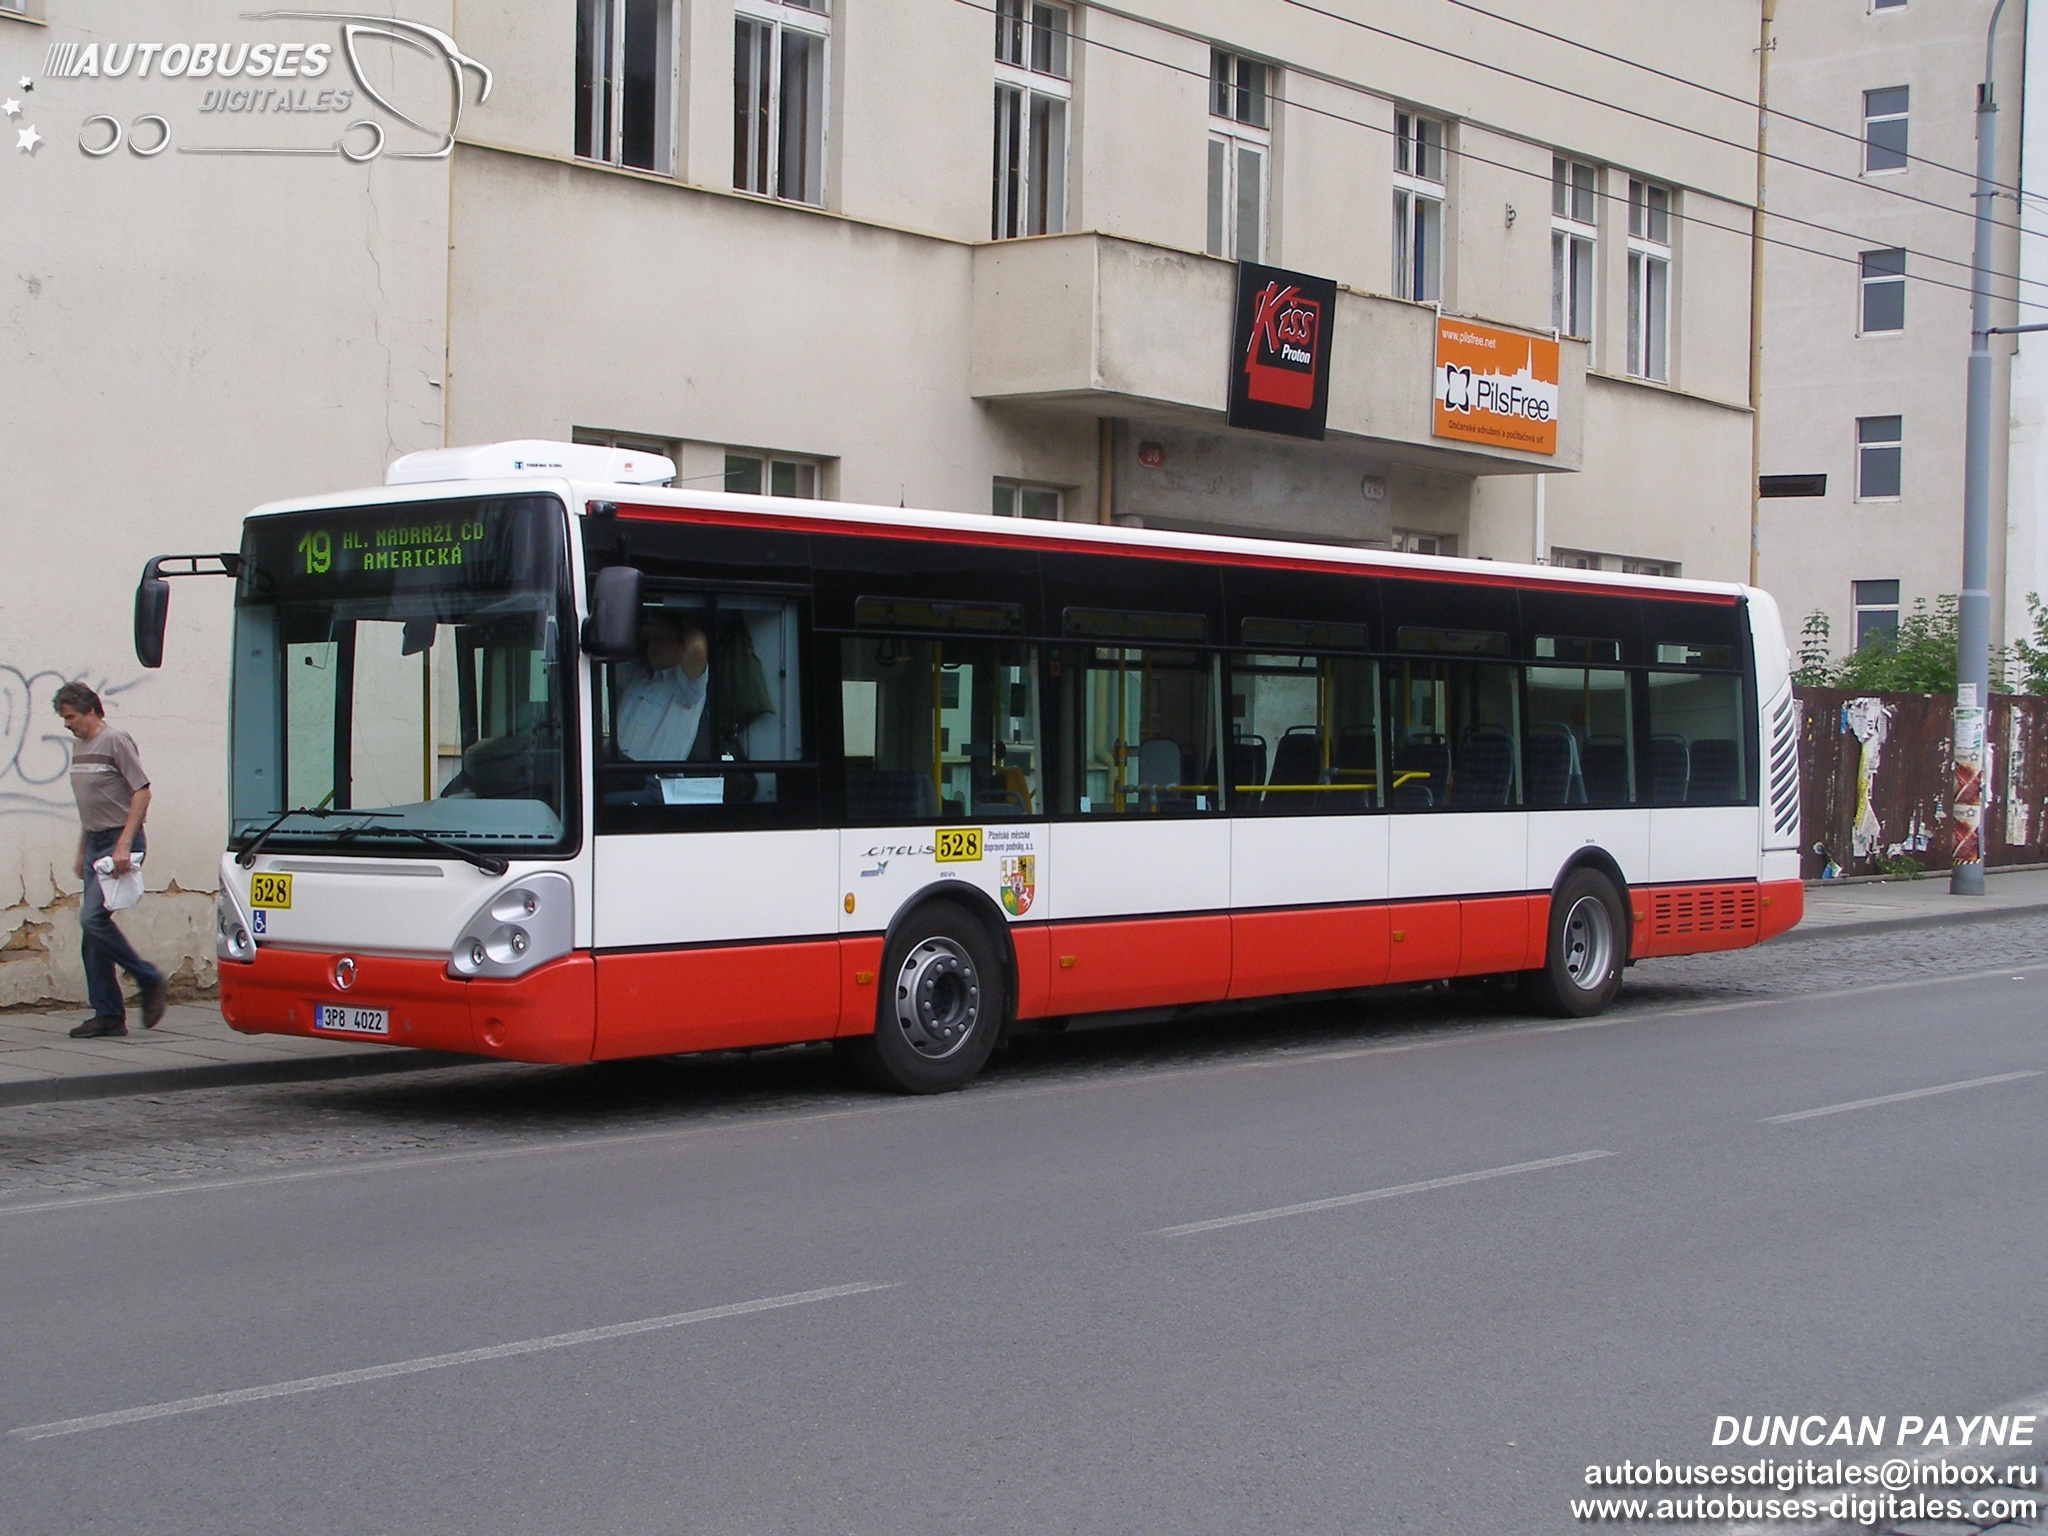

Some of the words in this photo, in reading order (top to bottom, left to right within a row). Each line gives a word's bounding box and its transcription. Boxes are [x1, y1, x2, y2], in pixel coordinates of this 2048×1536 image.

[1441, 328, 1497, 349] www.pilsfree.net
[1281, 343, 1312, 364] Proton
[1476, 379, 1550, 421] PilsFree
[343, 531, 368, 549] HL.
[461, 517, 484, 541] ČD
[299, 530, 331, 574] 19
[364, 542, 462, 570] AMERICKÁ
[941, 833, 977, 857] 528
[255, 878, 286, 903] 528
[325, 1008, 345, 1027] 3P8
[354, 1011, 382, 1030] 4022
